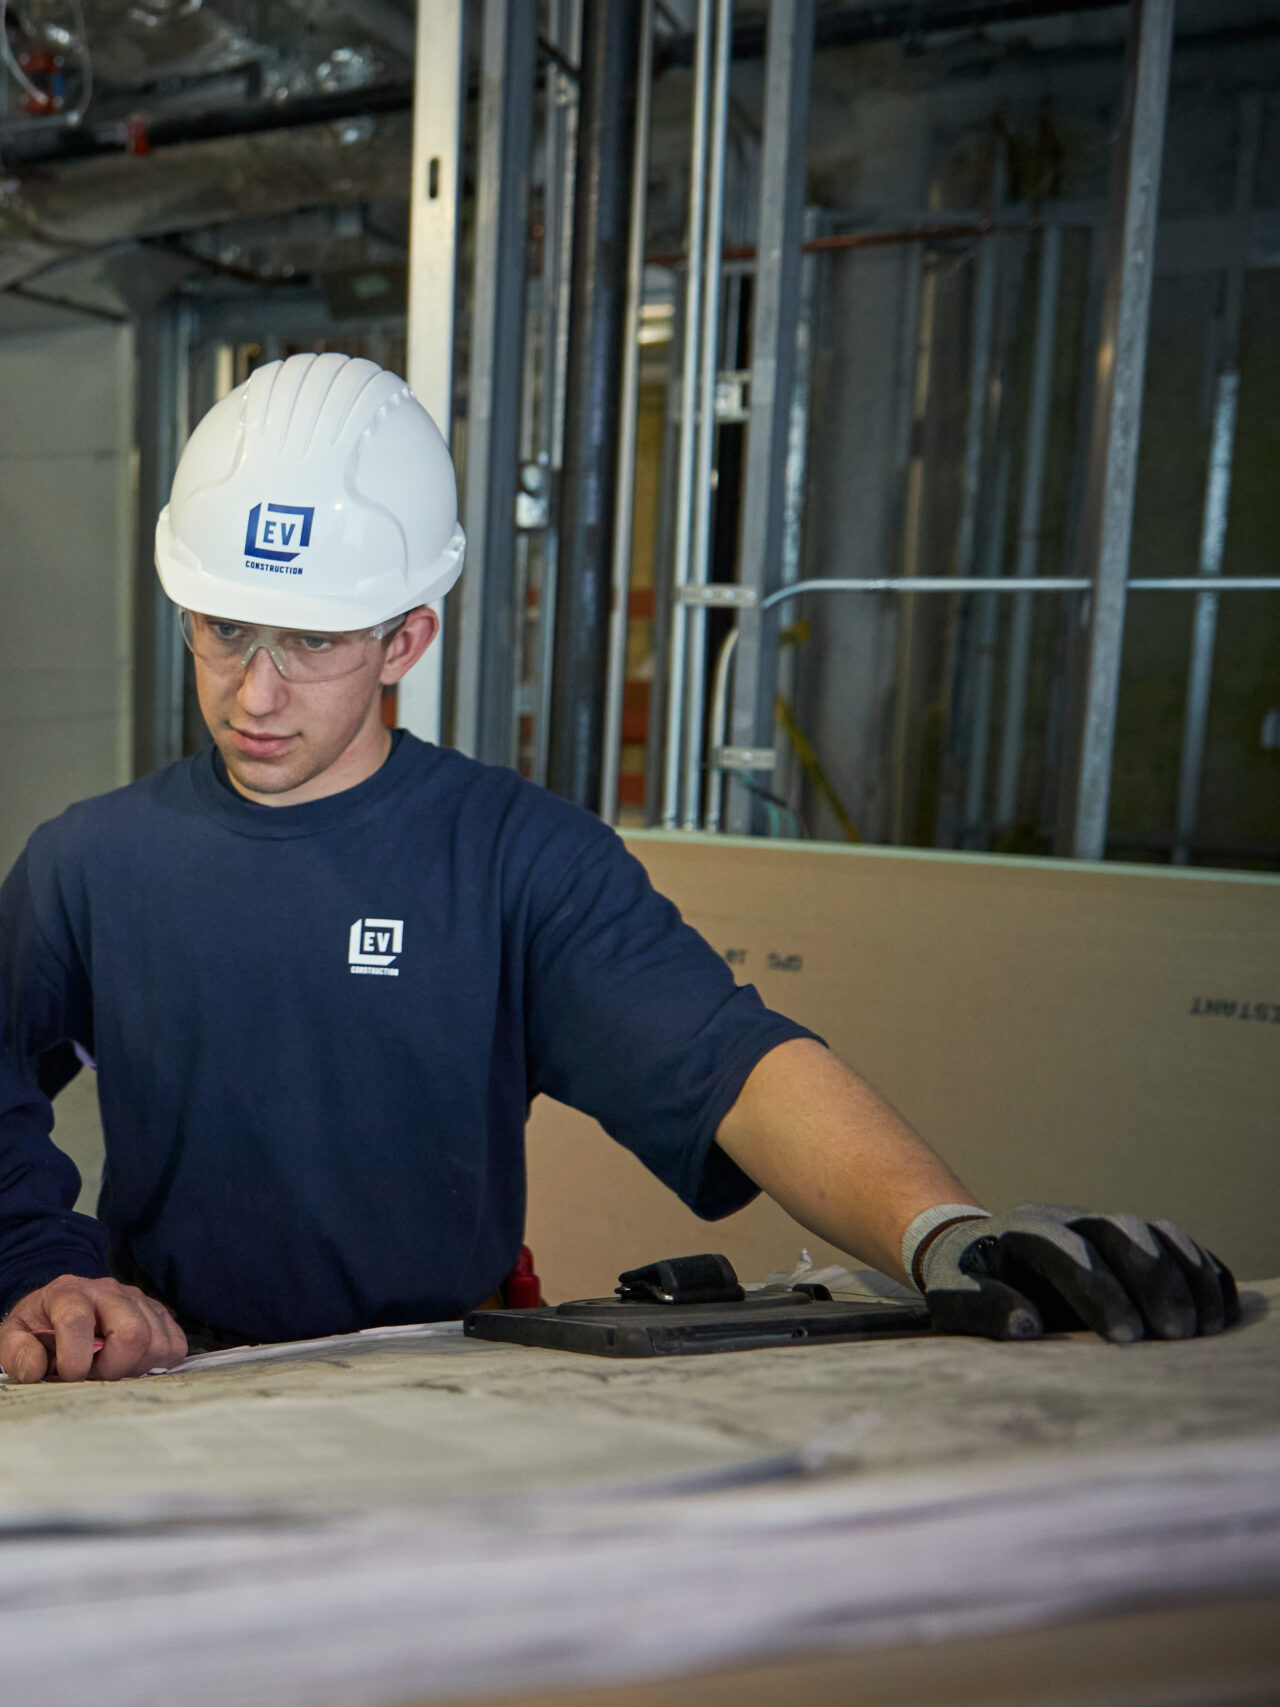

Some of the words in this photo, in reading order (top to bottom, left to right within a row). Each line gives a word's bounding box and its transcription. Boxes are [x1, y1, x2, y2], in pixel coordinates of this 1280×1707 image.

[263, 520, 296, 546] EV
[245, 560, 303, 575] CONSTRUCTION
[363, 931, 391, 952] EV
[350, 965, 399, 976] CONSTRUCTION
